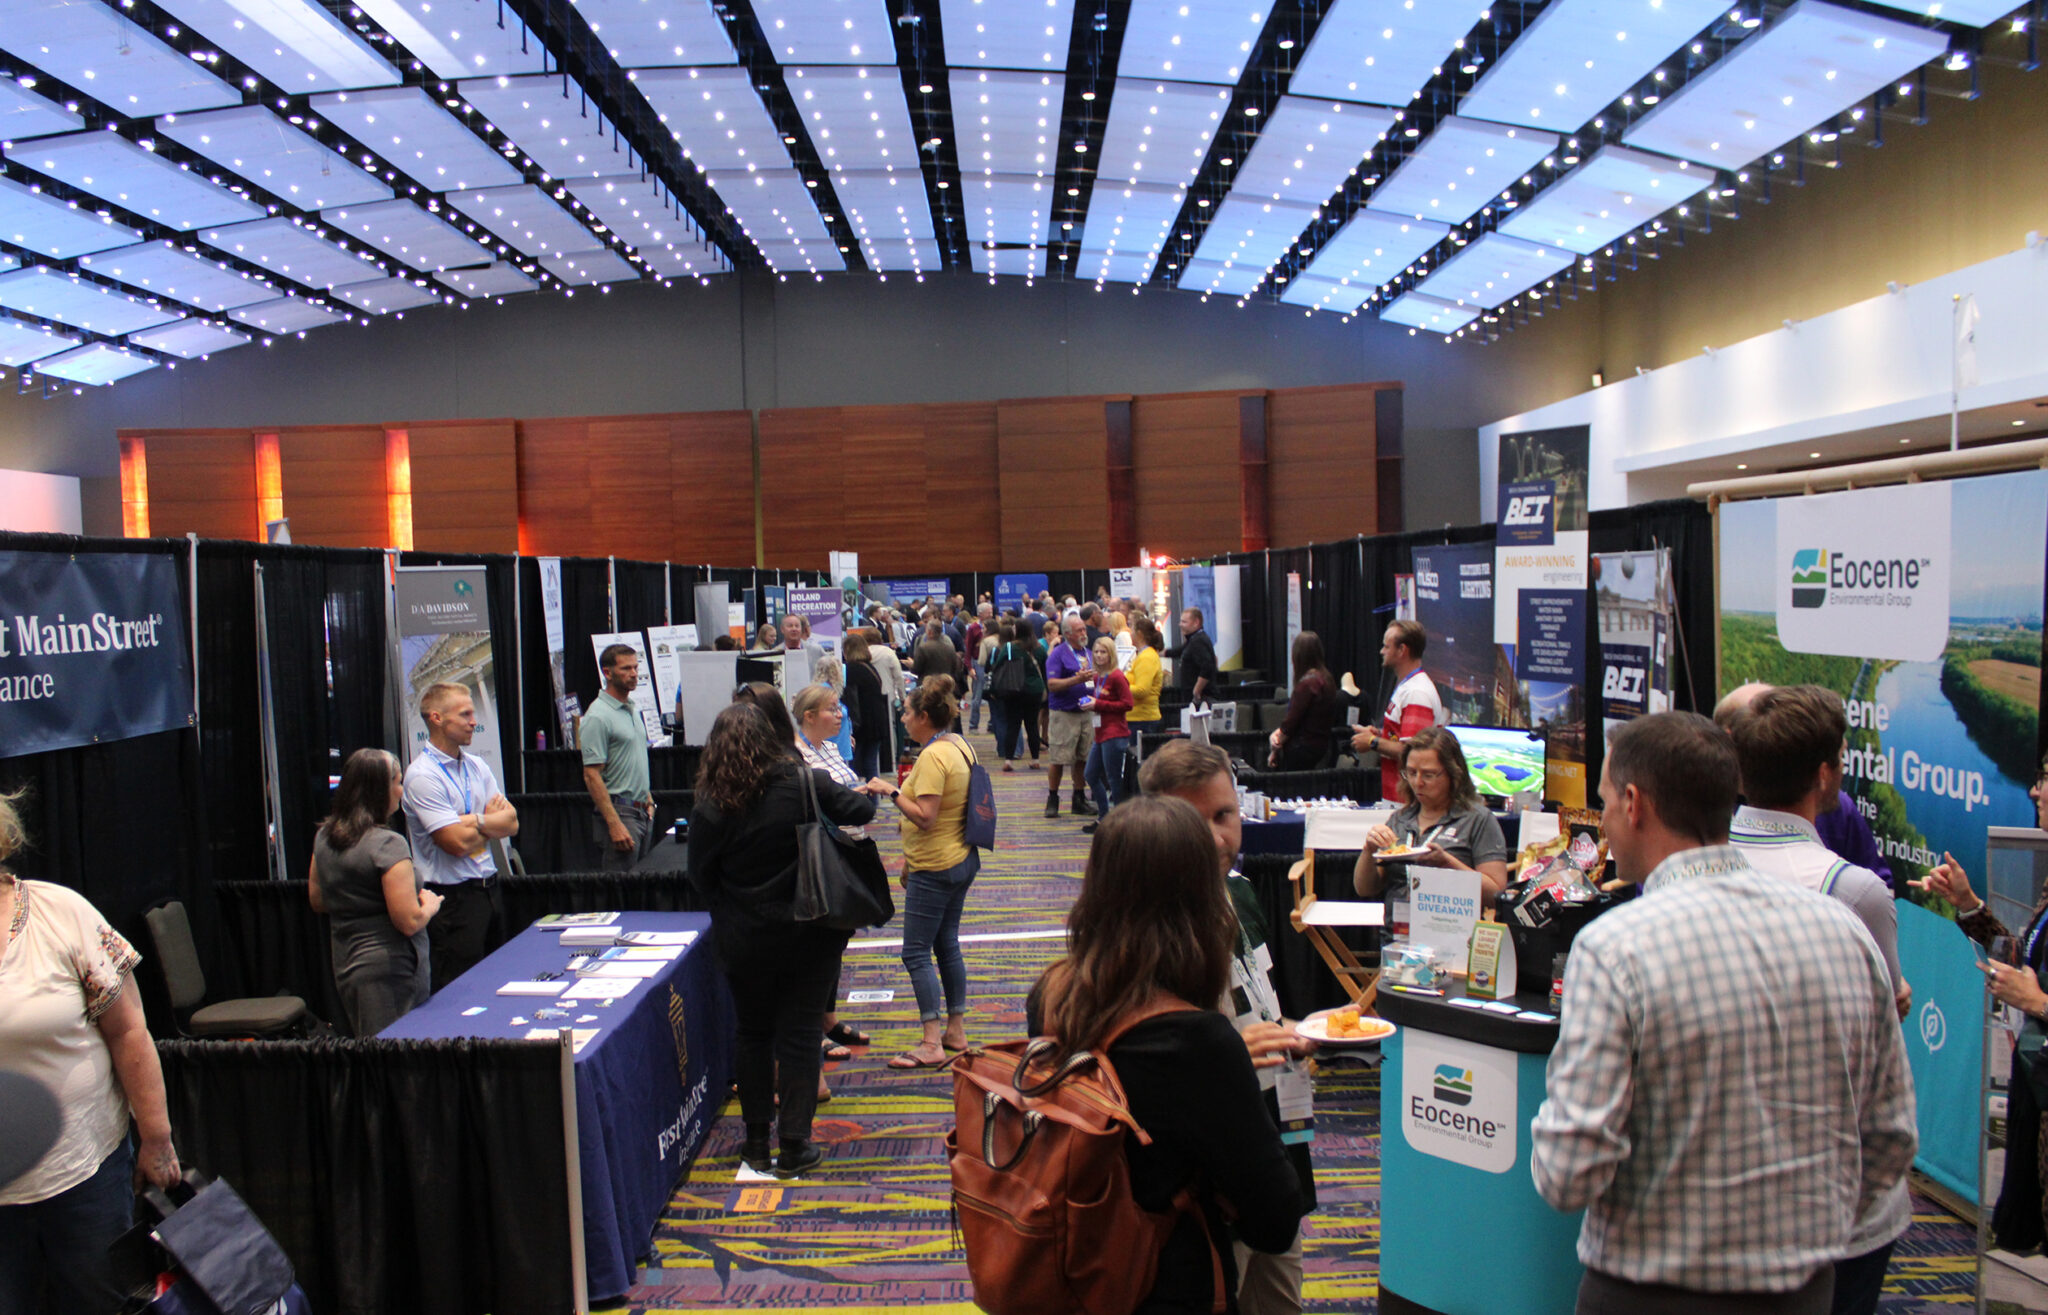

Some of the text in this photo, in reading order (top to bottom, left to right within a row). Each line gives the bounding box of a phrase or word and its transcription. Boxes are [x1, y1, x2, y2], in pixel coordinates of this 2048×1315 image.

[1504, 555, 1576, 568] AWARD-WINNING
[1543, 572, 1584, 585] engineering
[1831, 552, 1920, 589] Eocene
[790, 593, 821, 602] BOLAND
[1830, 593, 1912, 608] Environmental Group
[426, 602, 469, 614] DAVIDSON
[790, 601, 837, 612] RECREATION
[1842, 698, 1890, 732] ene
[1901, 749, 1990, 812] Group.
[1856, 795, 1878, 820] the
[1886, 834, 1942, 868] industry
[1417, 892, 1475, 908] ENTER OUR
[1417, 902, 1475, 917] GIVEAWAY!
[1411, 1095, 1497, 1139] Eocene
[1414, 1119, 1493, 1149] Environmental Group
